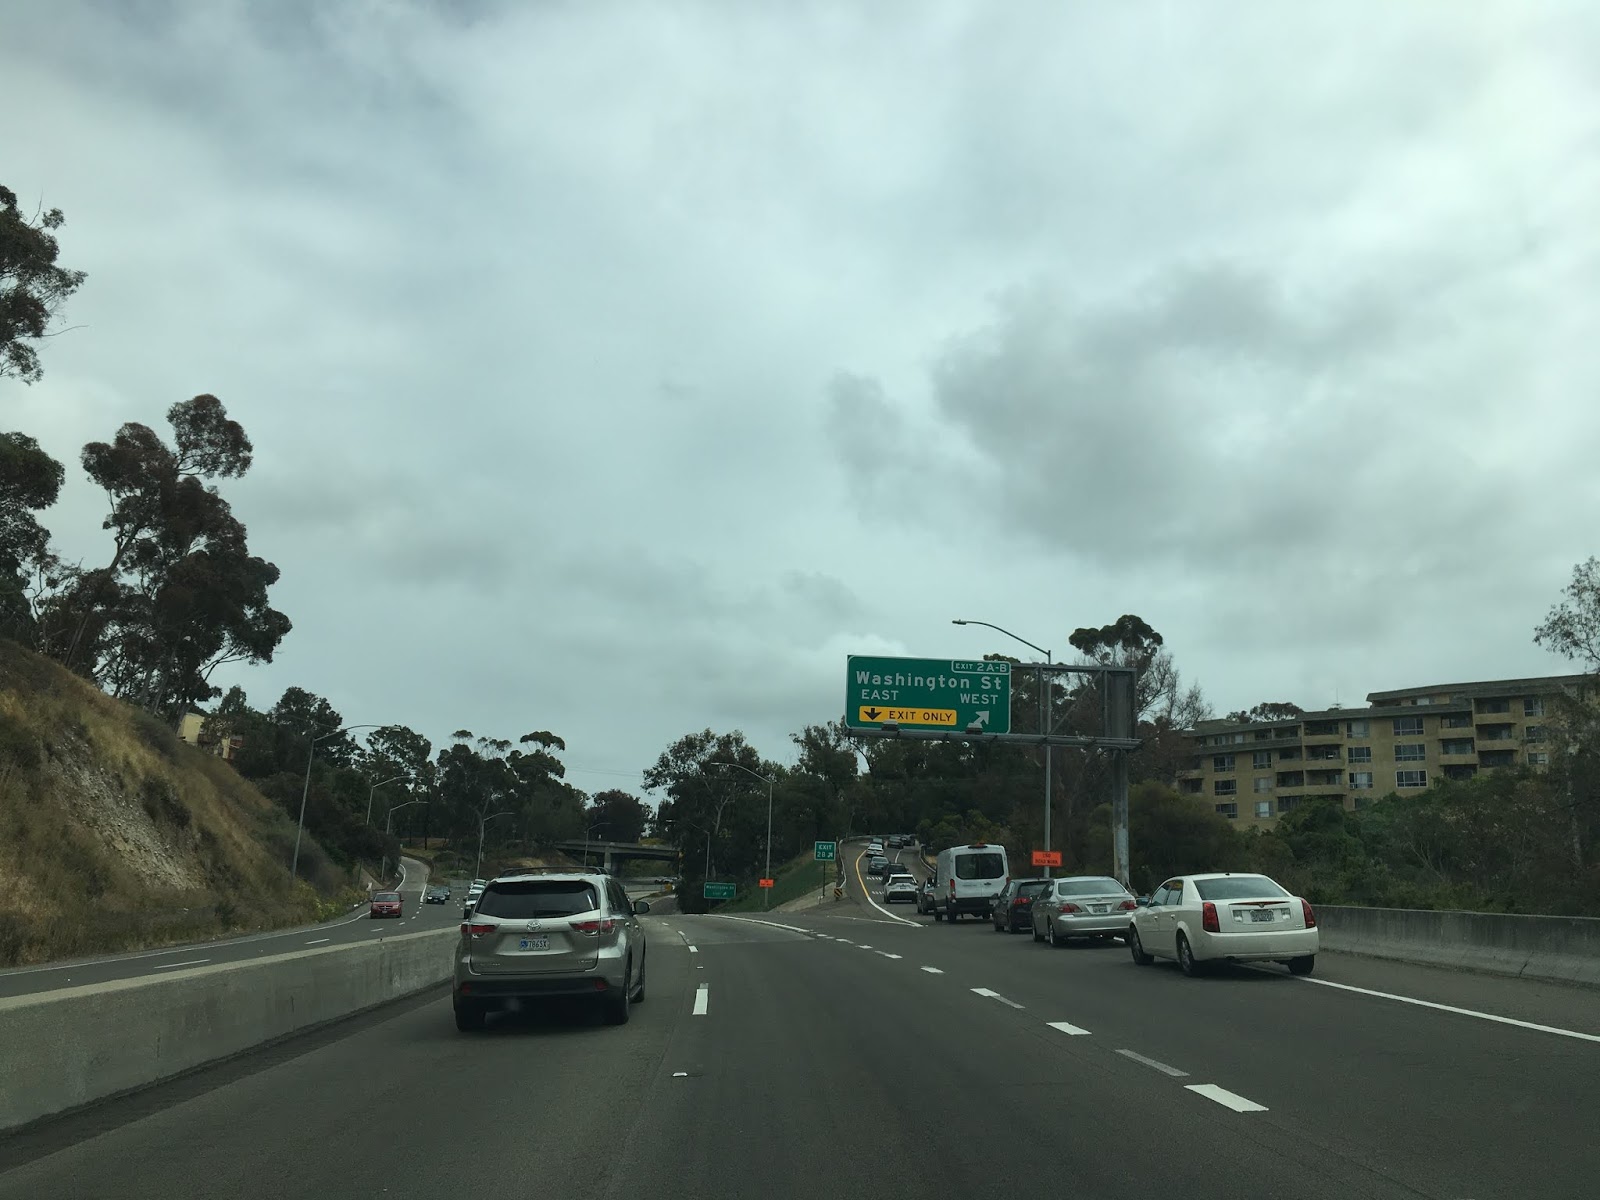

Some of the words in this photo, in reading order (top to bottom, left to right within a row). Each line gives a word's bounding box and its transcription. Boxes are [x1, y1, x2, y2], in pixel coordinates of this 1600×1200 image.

[976, 662, 1007, 673] 2A-B
[856, 670, 970, 691] Washington
[981, 676, 1002, 690] St
[861, 689, 899, 700] EAST
[960, 693, 999, 704] WEST
[888, 710, 916, 720] EXIT
[922, 711, 953, 722] ONLY
